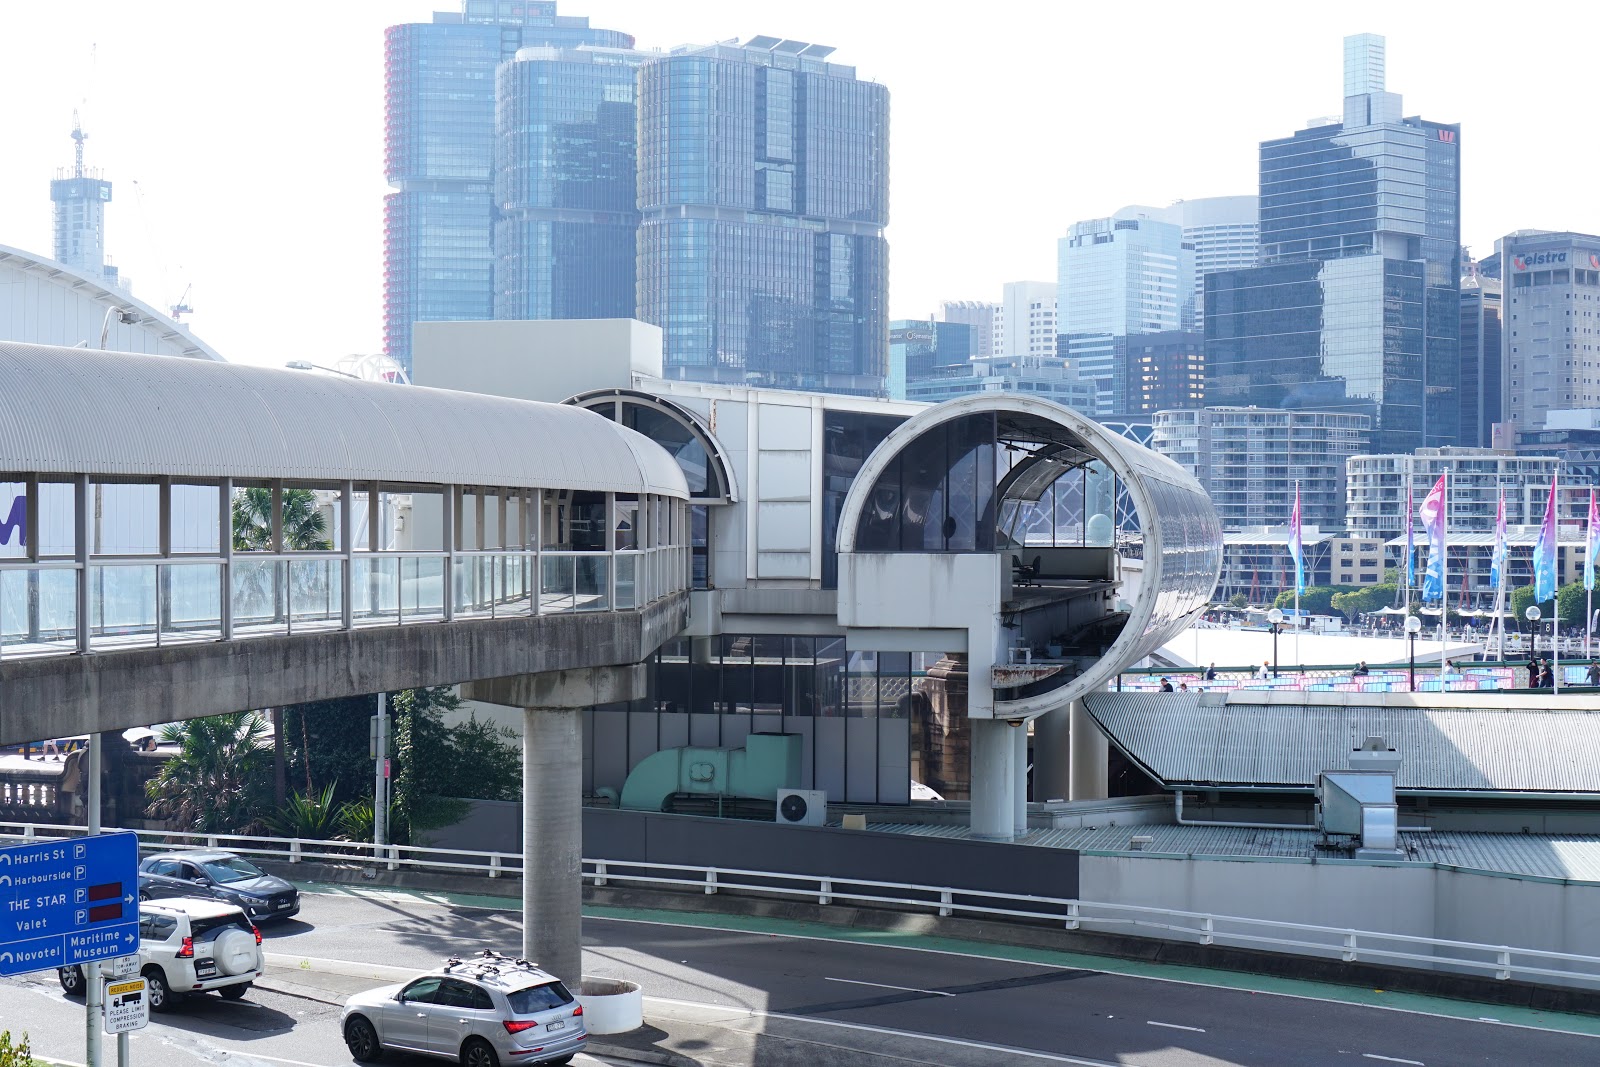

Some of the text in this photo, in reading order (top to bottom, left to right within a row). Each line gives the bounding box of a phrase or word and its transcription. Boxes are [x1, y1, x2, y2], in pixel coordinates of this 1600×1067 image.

[1514, 251, 1567, 270] Telstra
[14, 845, 84, 865] Harris St P
[14, 866, 85, 886] Harbourside P
[8, 889, 85, 912] THE STAR P
[16, 910, 86, 931] Valet P
[70, 931, 120, 947] Maritime
[16, 946, 60, 962] Novotel
[74, 944, 118, 959] Museum
[110, 1005, 145, 1016] PLEASE LIMIT
[110, 1012, 145, 1024] COMPRESSION
[116, 1020, 138, 1029] BRAKING
